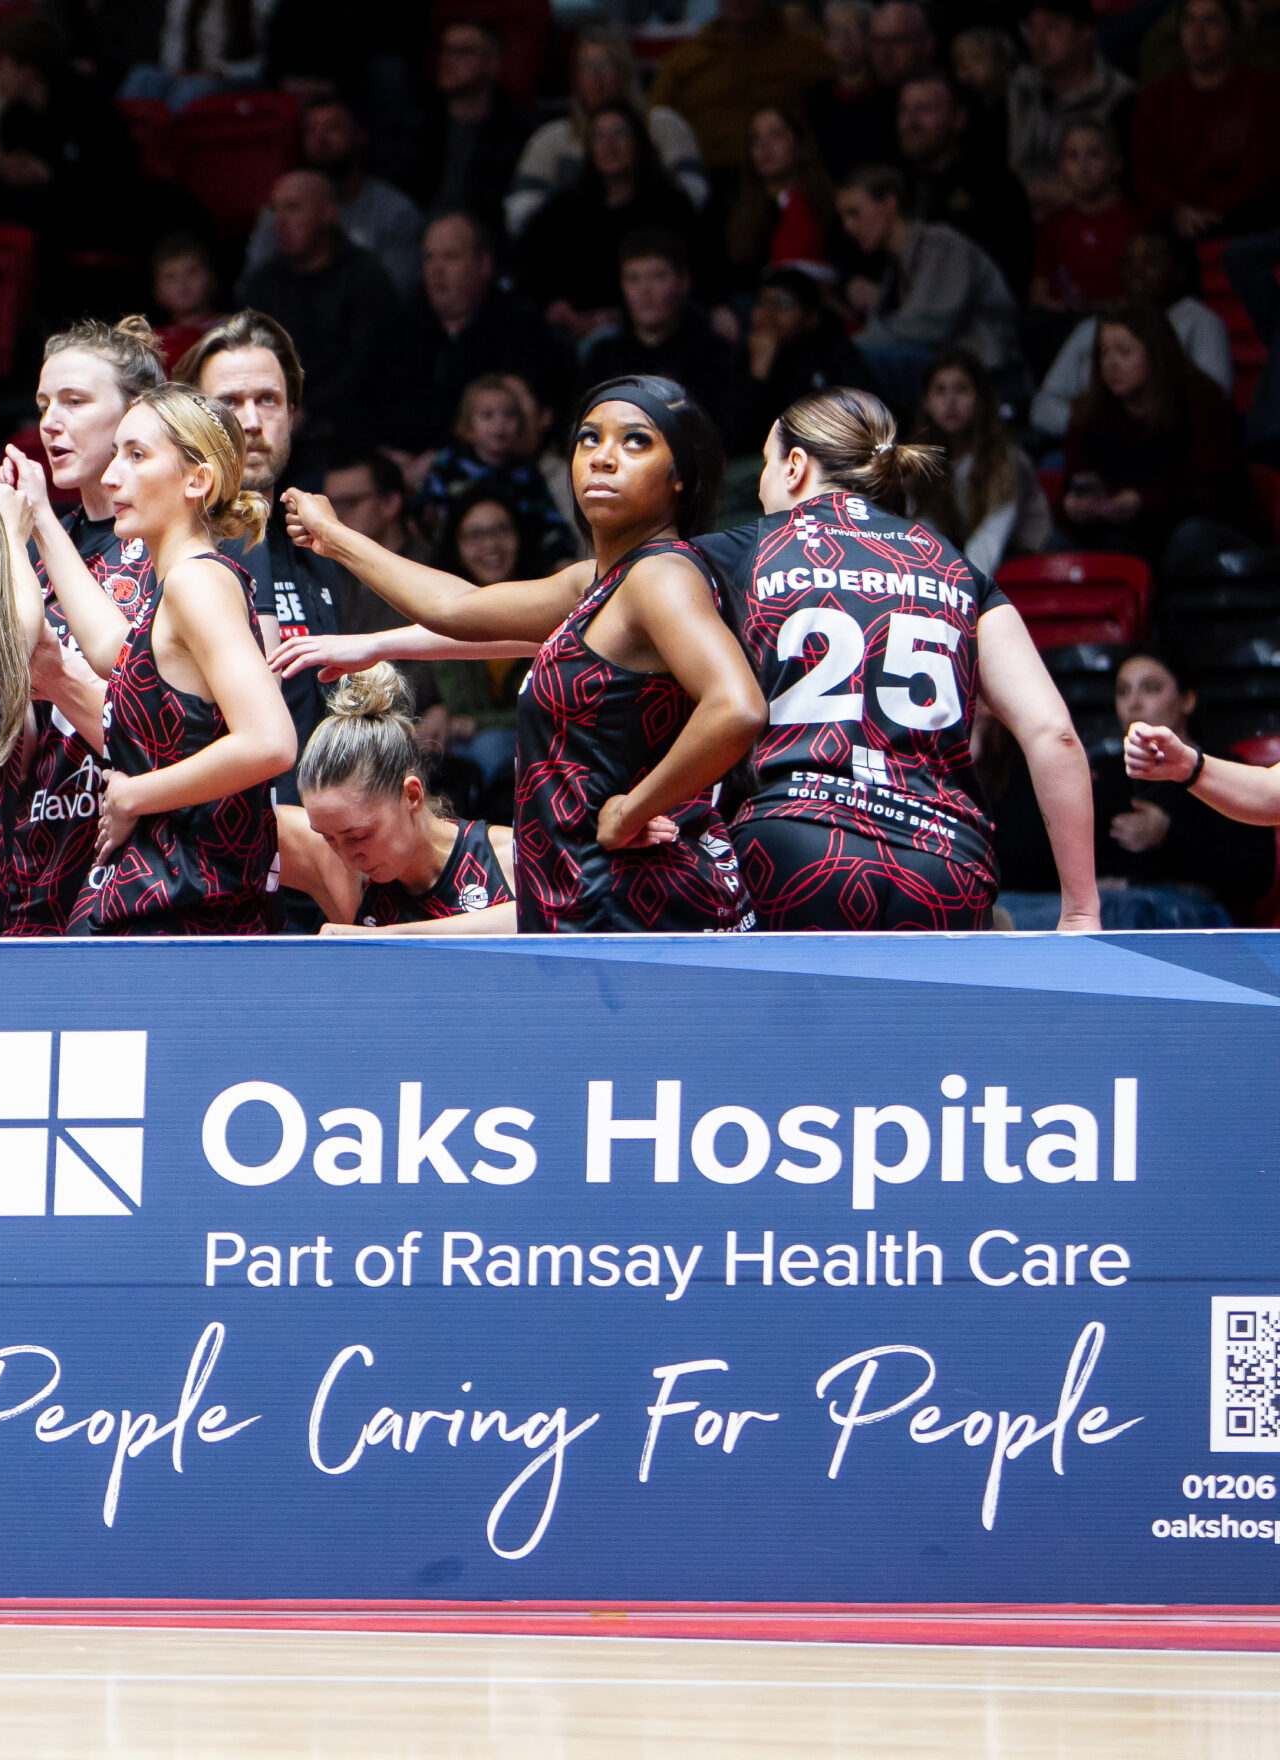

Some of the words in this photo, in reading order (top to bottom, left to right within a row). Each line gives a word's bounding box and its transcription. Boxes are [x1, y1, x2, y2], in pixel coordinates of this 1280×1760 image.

[824, 526, 881, 540] University
[883, 532, 895, 540] of
[757, 568, 973, 616] MCDERMENT
[769, 607, 962, 731] 25
[787, 787, 829, 801] BOLD
[835, 793, 905, 821] CURIOUS
[909, 815, 957, 840] BRAVE
[201, 1081, 538, 1187] Oaks
[586, 1074, 1138, 1210] Hospital
[205, 1232, 333, 1288] Part
[355, 1230, 423, 1288] of
[442, 1231, 703, 1301] Ramsay
[726, 1230, 943, 1287] Health
[969, 1229, 1130, 1287] Care
[308, 1344, 600, 1560] Caring
[638, 1358, 780, 1483] For
[815, 1321, 1146, 1531] People
[1182, 1474, 1277, 1500] 01206
